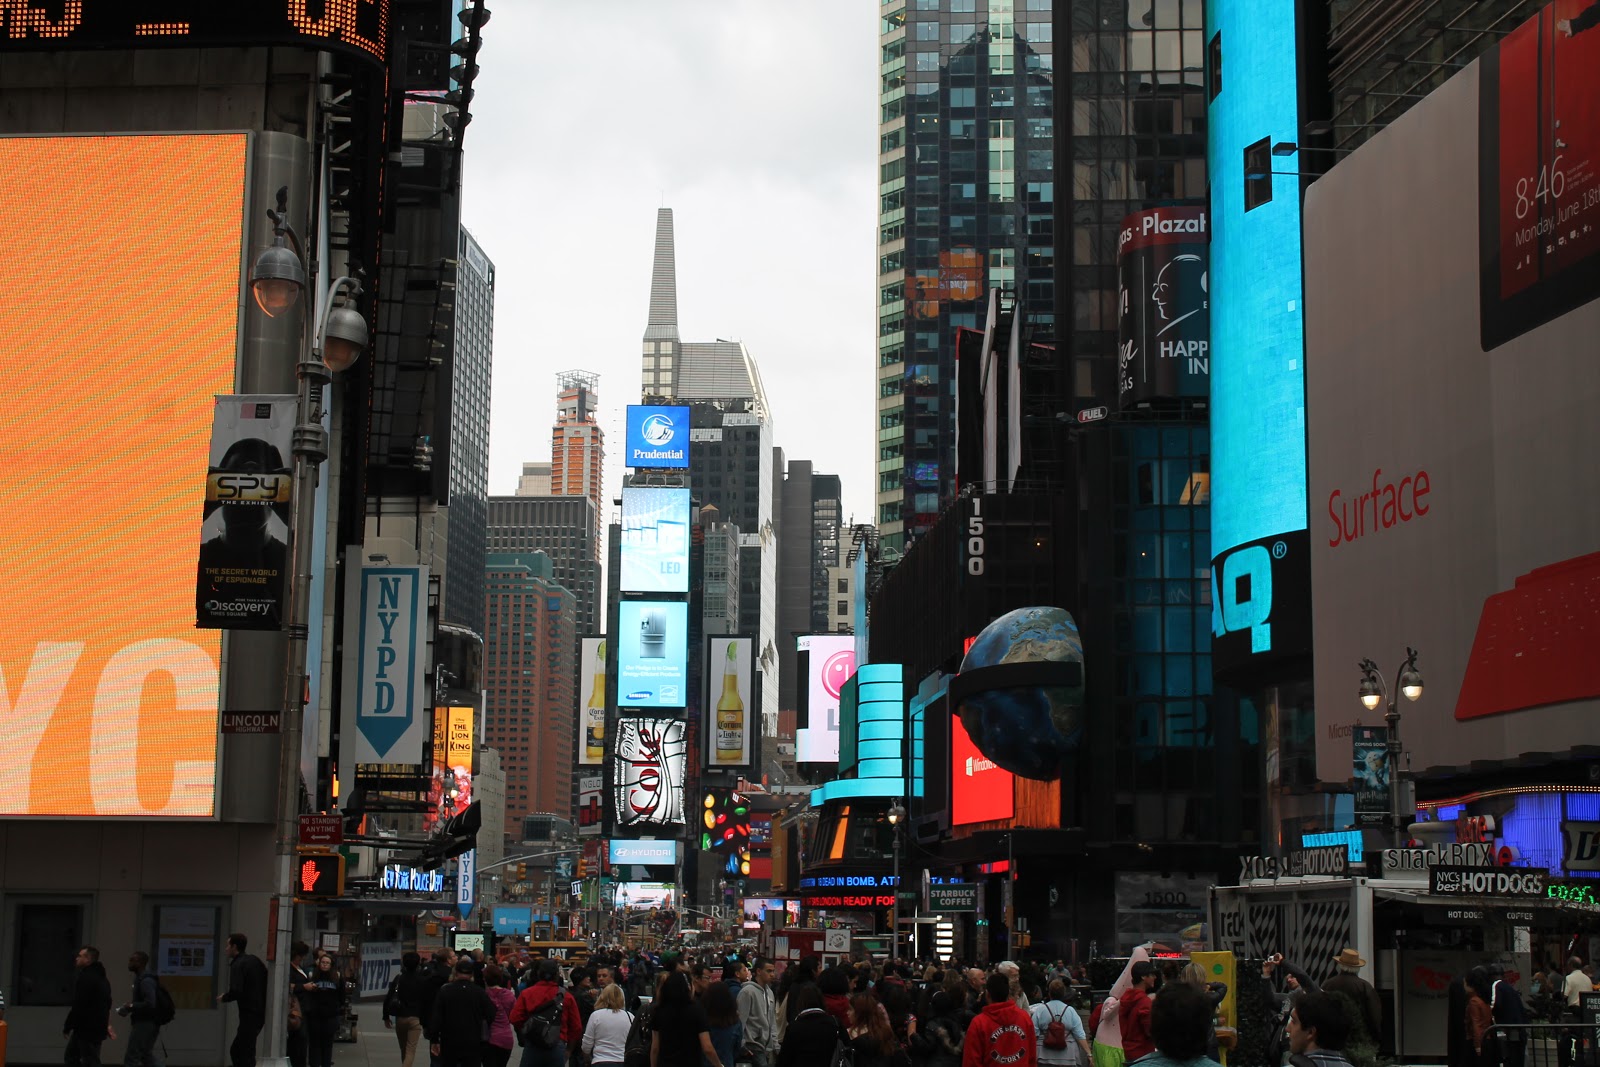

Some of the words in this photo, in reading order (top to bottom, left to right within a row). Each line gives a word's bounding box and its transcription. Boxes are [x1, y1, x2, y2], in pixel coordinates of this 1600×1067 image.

[1515, 155, 1565, 219] 8:46
[1515, 216, 1556, 247] Monday,
[1556, 201, 1580, 226] June
[1082, 407, 1104, 420] FUEL
[633, 449, 684, 460] Prudential
[217, 476, 280, 499] SPY
[1328, 468, 1431, 548] Surface
[968, 498, 984, 576] 1500
[205, 567, 220, 575] THE
[221, 568, 250, 576] SECRET
[250, 568, 278, 577] WORLD
[660, 561, 681, 574] LED
[225, 576, 268, 585] ESPIONAGE
[209, 600, 271, 616] Discovery
[373, 577, 401, 714] NYPD
[223, 714, 279, 727] LINCOLN
[451, 730, 469, 740] LION
[450, 741, 471, 752] KING
[581, 779, 603, 789] INGLO
[301, 817, 310, 825] NO
[311, 817, 340, 825] STANDING
[631, 849, 672, 857] HYUNDAI
[1388, 842, 1494, 869] snackBOX
[1302, 849, 1321, 874] HOT
[1320, 847, 1345, 873] DOGS
[836, 877, 845, 886] IN
[846, 876, 878, 887] BOMB,
[1436, 881, 1461, 892] best
[1461, 872, 1497, 892] HOT
[1497, 873, 1544, 895] DOGS
[843, 896, 874, 906] READY
[1144, 891, 1187, 904] 1500
[1447, 910, 1462, 918] HOT
[547, 948, 568, 961] CAT
[360, 959, 391, 992] NYPD
